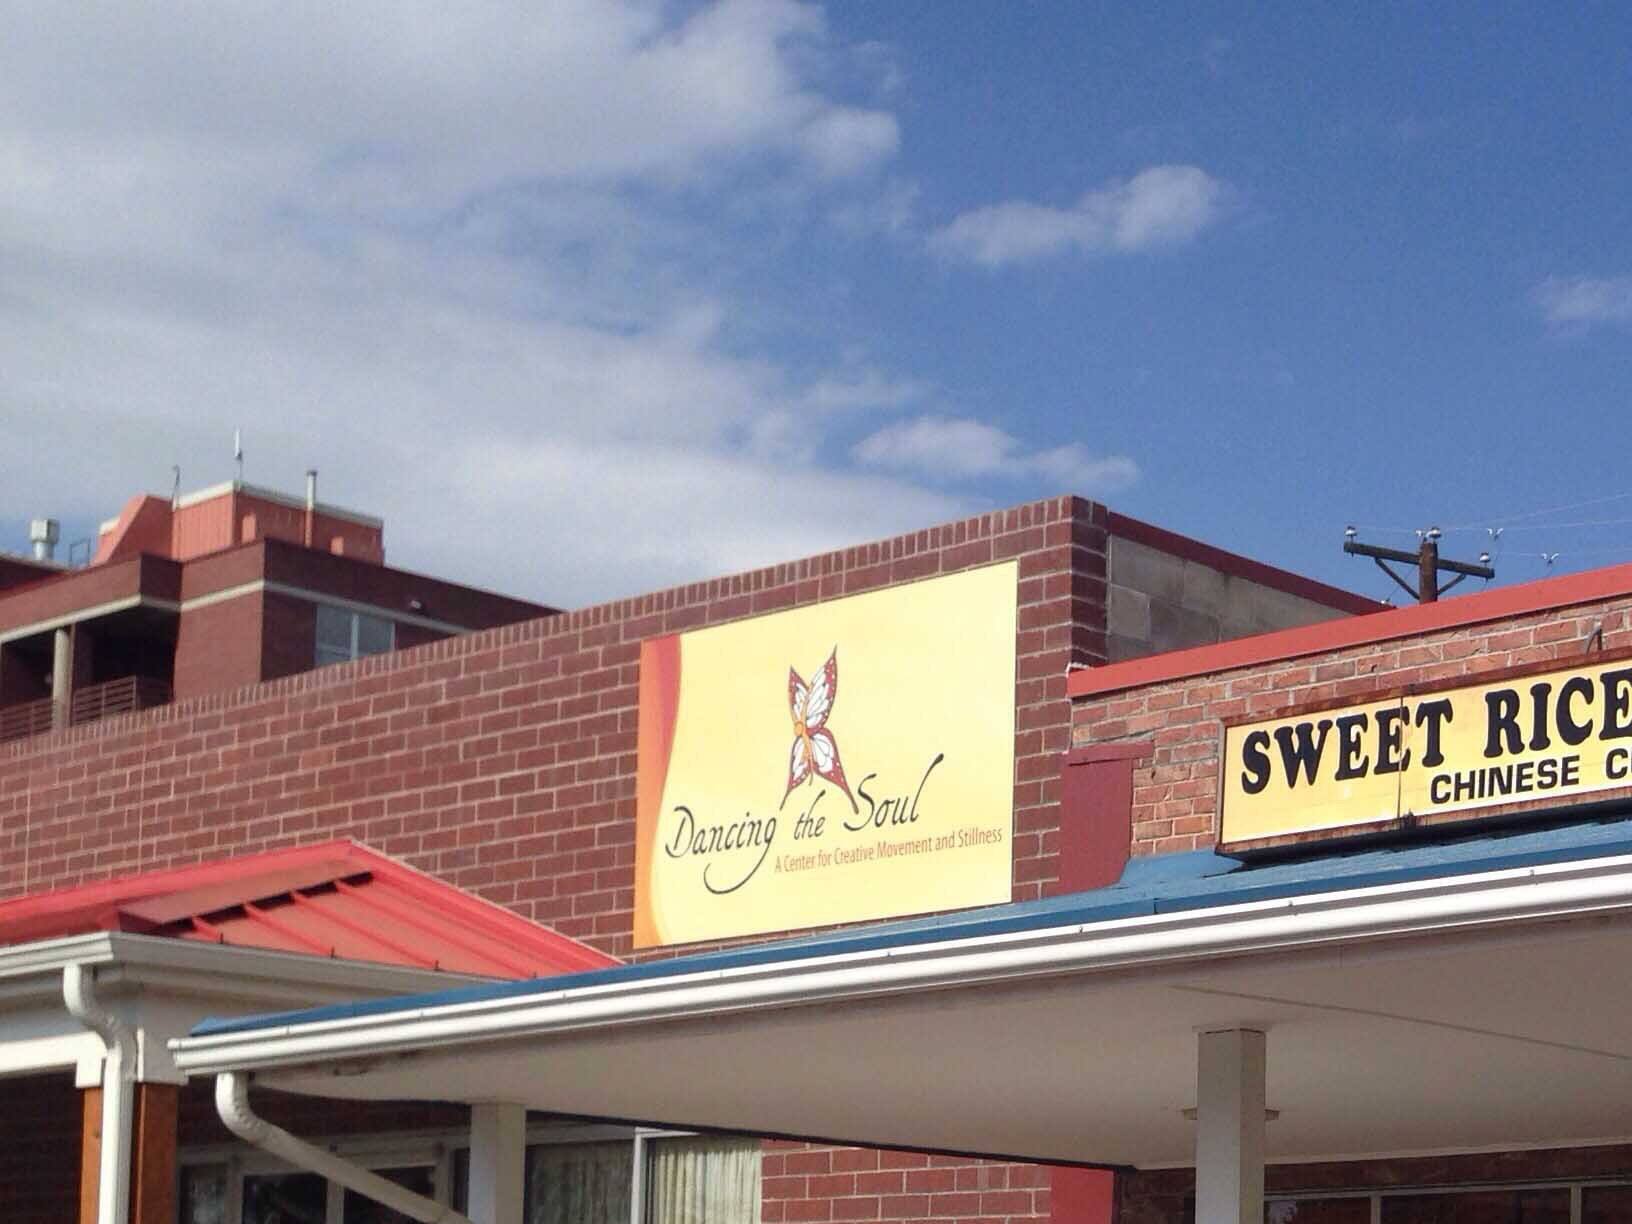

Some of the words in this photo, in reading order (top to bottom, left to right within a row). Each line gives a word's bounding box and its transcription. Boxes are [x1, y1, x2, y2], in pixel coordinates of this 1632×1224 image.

[1240, 697, 1454, 795] SWEET
[1429, 754, 1581, 805] CHINESE
[664, 804, 779, 895] Dancing
[793, 789, 827, 841] the
[843, 753, 945, 833] Soul
[775, 855, 782, 873] A
[784, 854, 816, 872] Center
[817, 849, 832, 868] for
[833, 846, 874, 866] Creative
[876, 837, 932, 858] Movement
[935, 831, 956, 851] and
[957, 826, 1003, 848] Stillness
